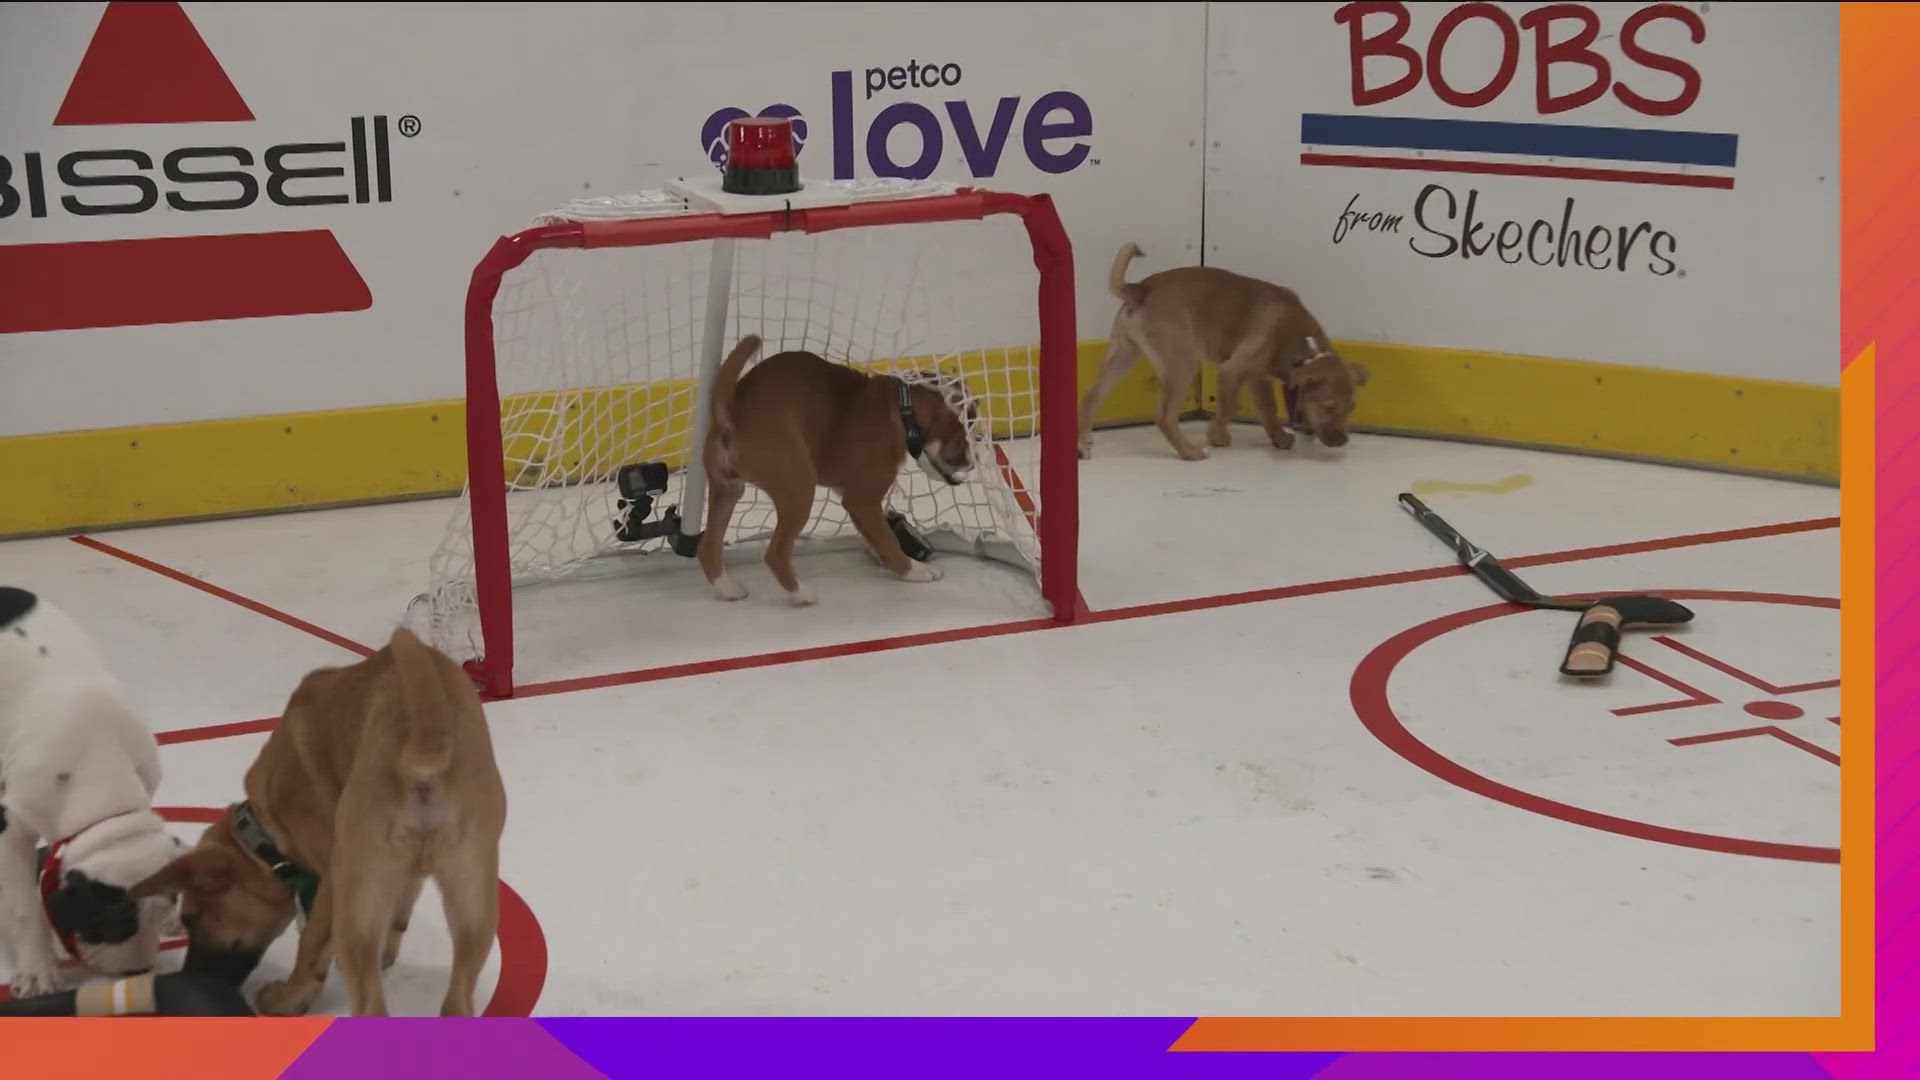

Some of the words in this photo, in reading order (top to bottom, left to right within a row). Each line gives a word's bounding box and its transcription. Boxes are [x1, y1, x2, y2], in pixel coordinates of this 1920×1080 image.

[865, 59, 962, 100] petco
[1334, 2, 1706, 116] BOBS
[1333, 193, 1404, 244] from
